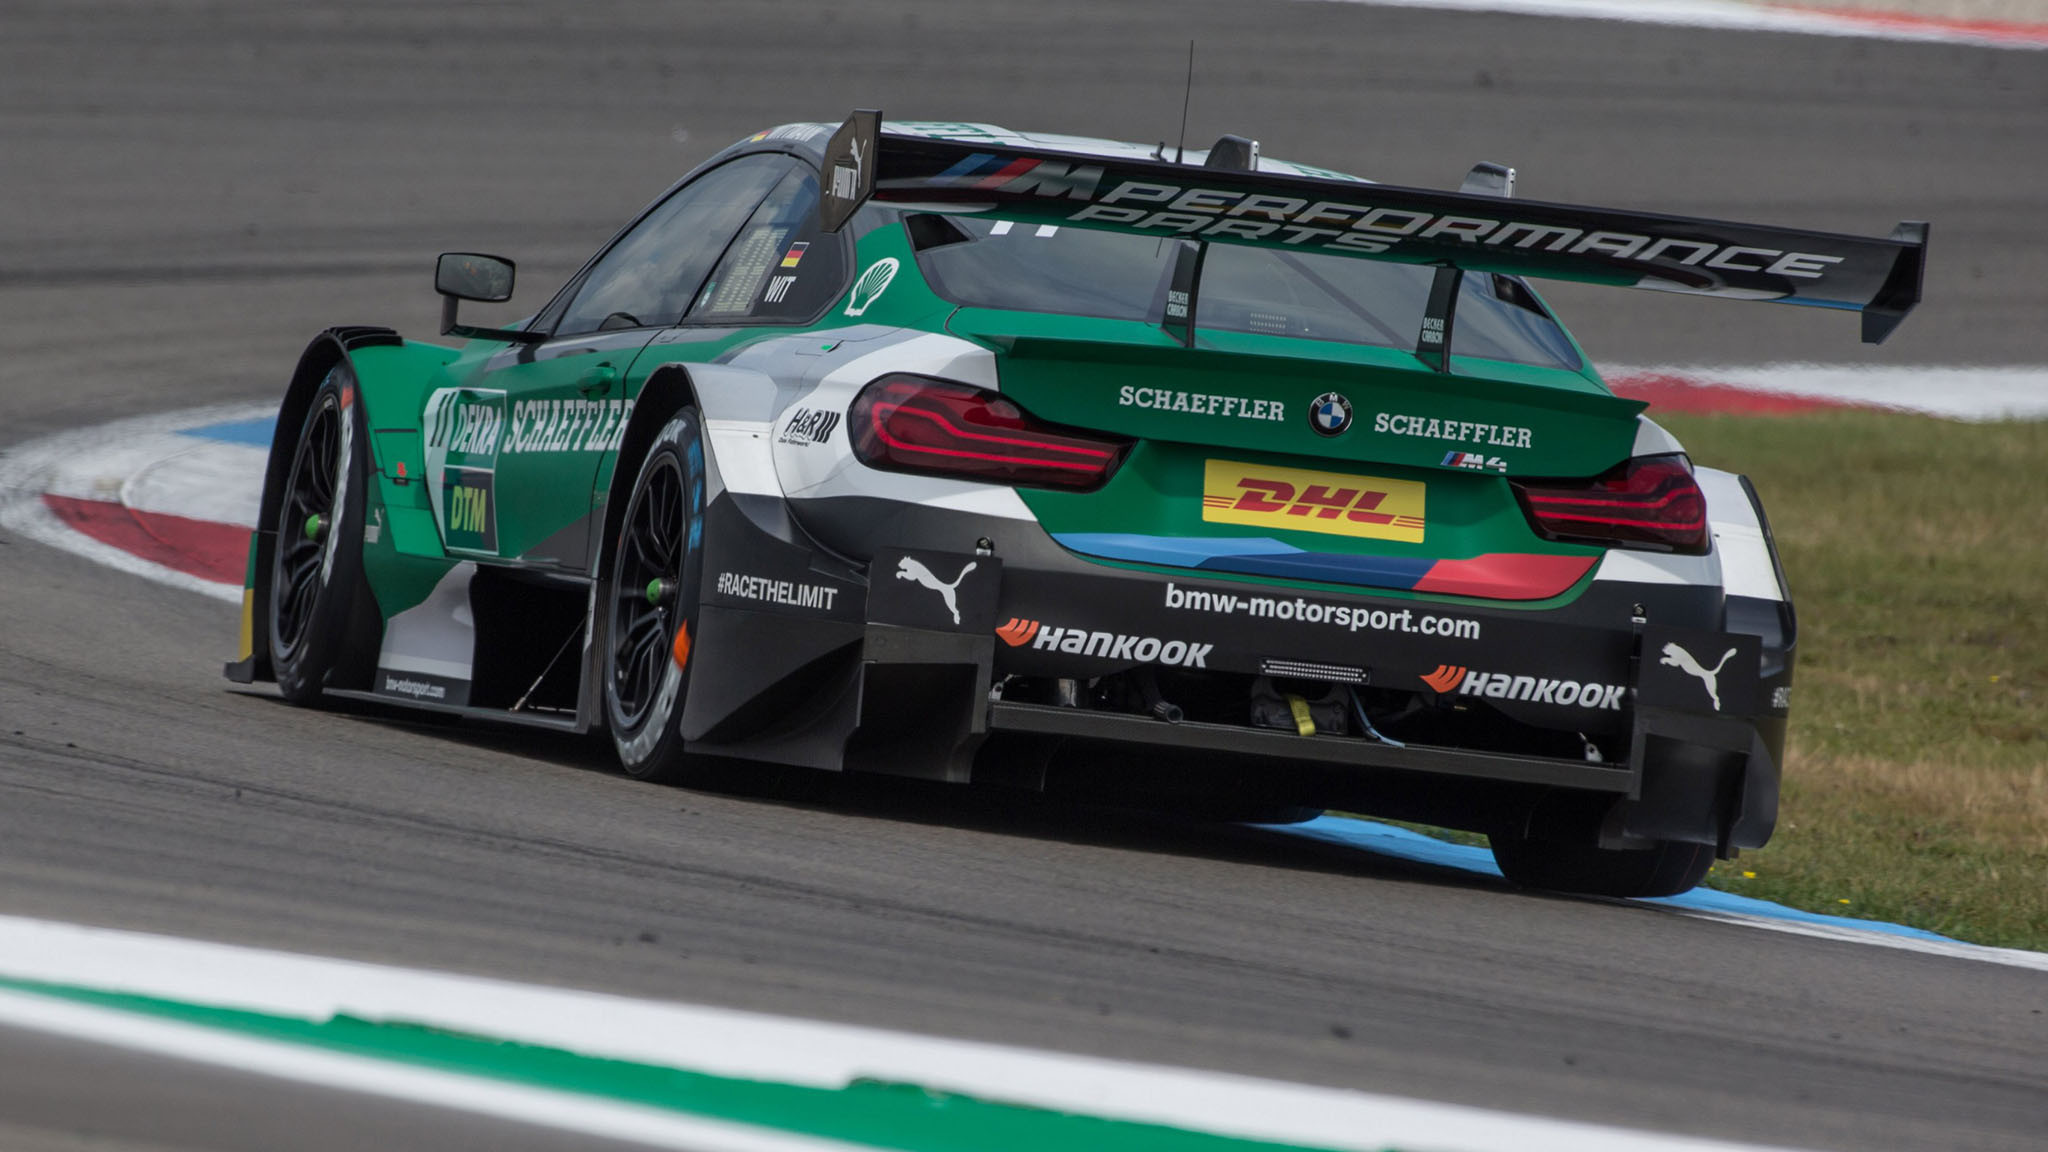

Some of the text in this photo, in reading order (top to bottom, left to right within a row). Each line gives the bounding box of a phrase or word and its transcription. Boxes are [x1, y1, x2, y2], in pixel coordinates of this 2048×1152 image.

[1067, 205, 1401, 254] PARTS
[1101, 181, 1845, 279] PERFORMANCE
[764, 275, 797, 303] WIT
[502, 399, 636, 454] SCHAEFFLER
[783, 408, 823, 441] H&R
[1119, 385, 1285, 422] SCHAEFFLER
[451, 403, 503, 456] DEKRA
[1374, 412, 1533, 449] SCHAEFFLER
[1458, 452, 1508, 473] M4
[451, 485, 487, 534] DTM
[1233, 477, 1397, 525] DHL
[717, 572, 838, 610] #RACETHELIMIT
[1165, 583, 1481, 640] bmw-motorsport.com
